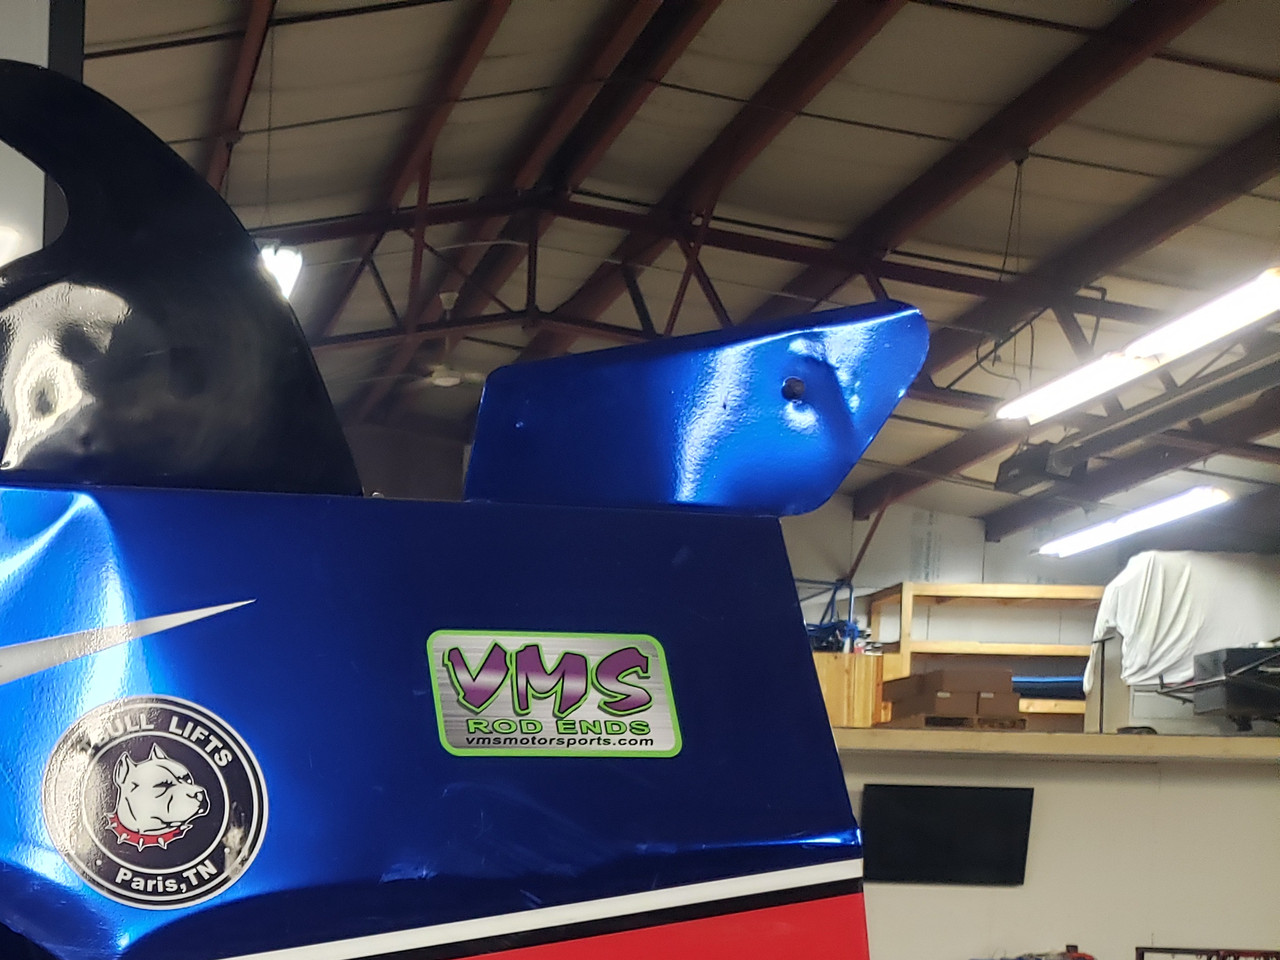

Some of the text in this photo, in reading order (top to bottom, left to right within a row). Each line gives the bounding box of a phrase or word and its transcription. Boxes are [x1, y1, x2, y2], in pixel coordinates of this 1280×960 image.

[442, 639, 653, 719] VMS
[169, 715, 233, 768] LIFTS
[465, 735, 654, 748] vmsmotorsports.com
[466, 718, 651, 735] ROD ENDS
